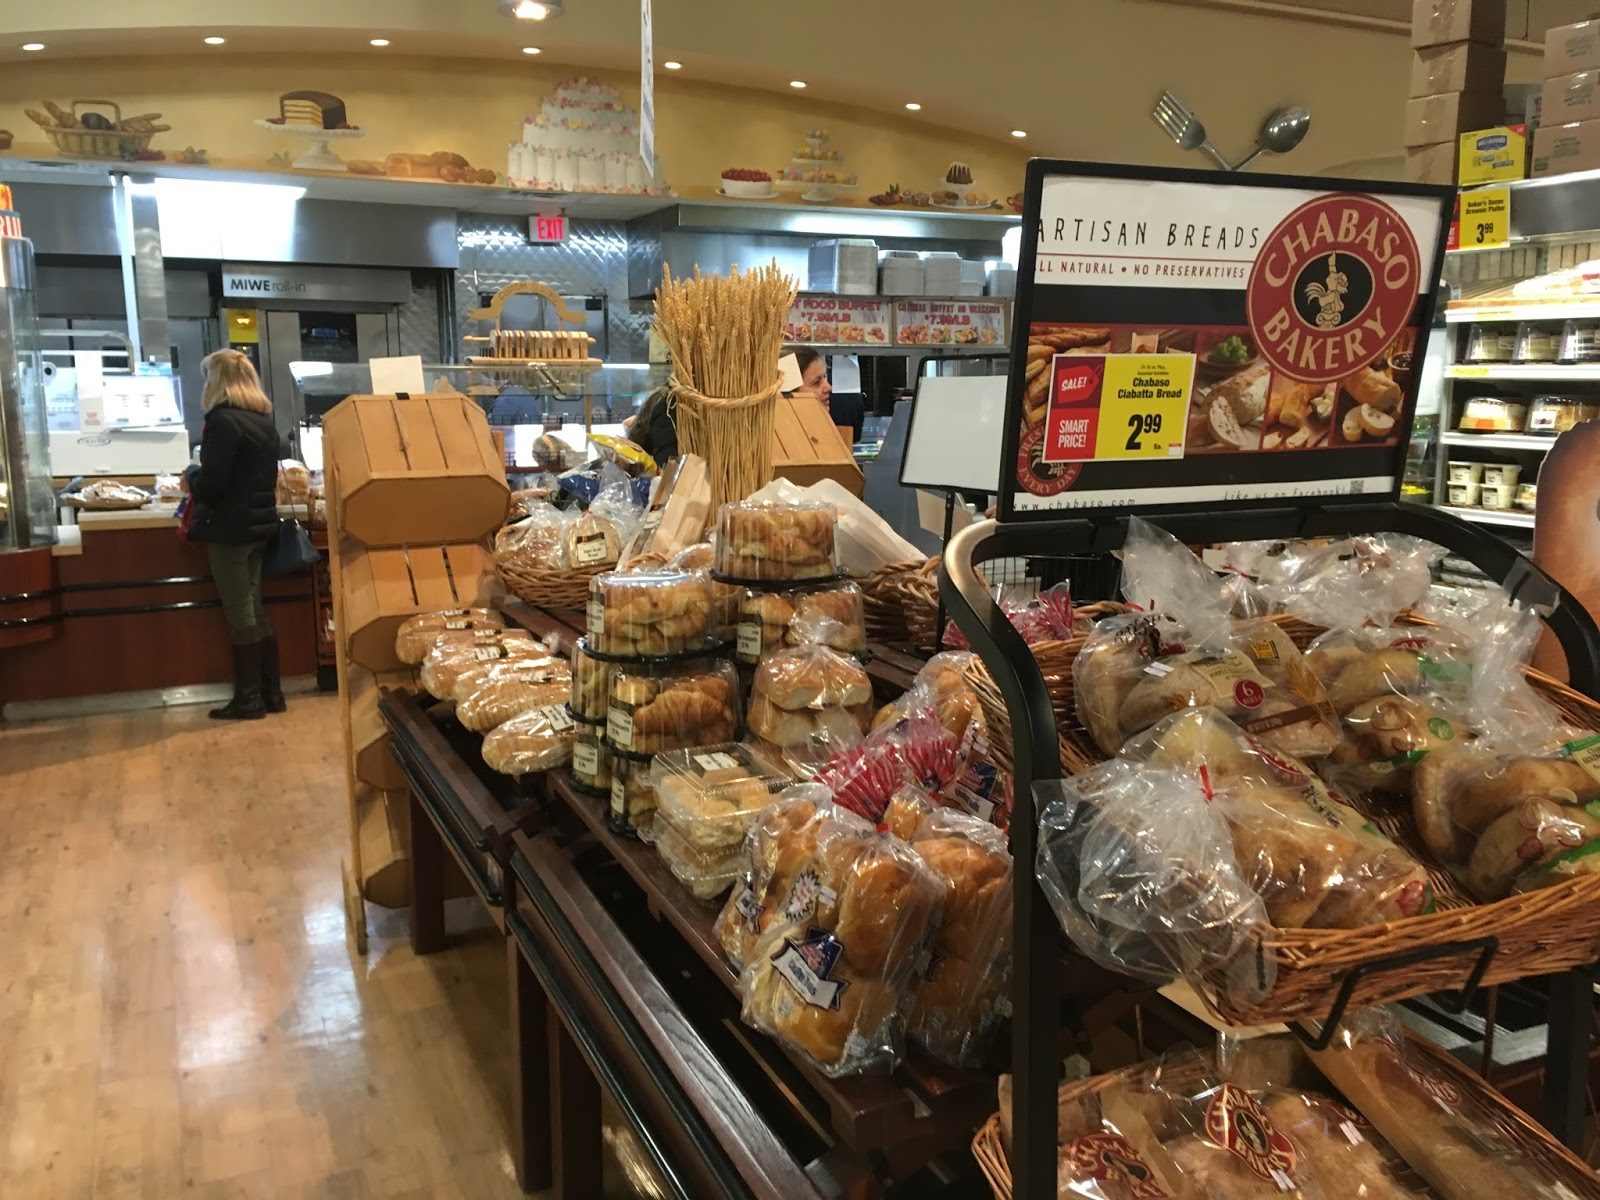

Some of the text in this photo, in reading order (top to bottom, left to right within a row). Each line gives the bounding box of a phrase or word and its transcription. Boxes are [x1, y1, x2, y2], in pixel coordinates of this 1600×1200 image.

[537, 217, 564, 240] EXIT
[1037, 217, 1259, 250] ARTISAN BREADS
[1264, 208, 1410, 290] CHABASO
[1036, 260, 1246, 278] LL NATURAL NO PRESERVATIVES
[230, 278, 271, 291] MIWE
[803, 299, 836, 310] FOOD
[838, 300, 881, 311] BUFFET
[1262, 306, 1388, 371] BAKERY
[1061, 376, 1088, 391] SALE!
[1132, 376, 1170, 388] Chabaso
[1117, 388, 1183, 399] Ciabatta Bread
[1058, 419, 1090, 434] SMART
[1057, 434, 1087, 449] PRICE!
[1018, 428, 1077, 494] FRES EVERY DAY
